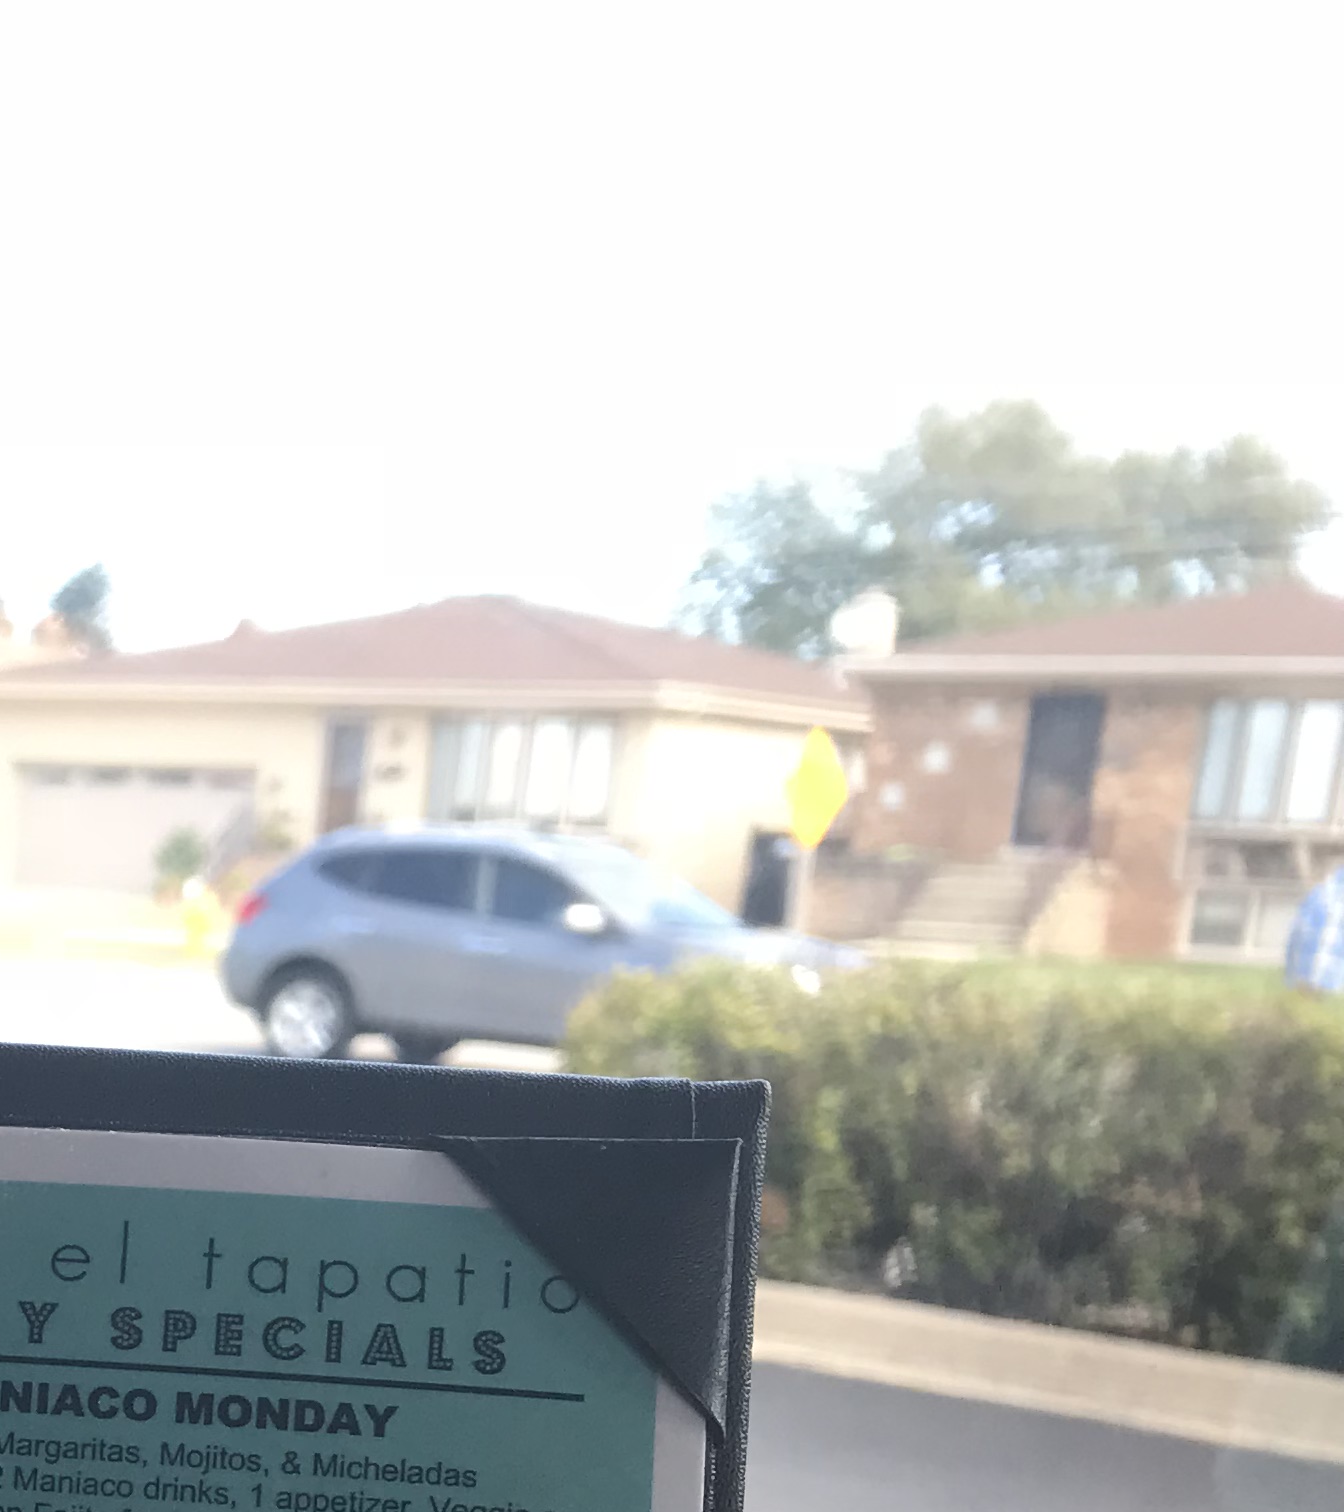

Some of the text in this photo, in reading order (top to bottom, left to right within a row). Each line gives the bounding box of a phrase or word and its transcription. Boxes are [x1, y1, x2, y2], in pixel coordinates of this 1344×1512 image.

[51, 1220, 128, 1283] el
[203, 1237, 577, 1313] tapatio
[110, 1306, 505, 1374] SPECIALS
[175, 1391, 398, 1437] MONDAY
[13, 1466, 133, 1498] Maniaco
[143, 1475, 235, 1508] drinks,
[251, 1483, 261, 1507] 1
[160, 1441, 268, 1476] Mojitos,
[280, 1451, 300, 1474] &
[312, 1453, 476, 1487] Micheladas
